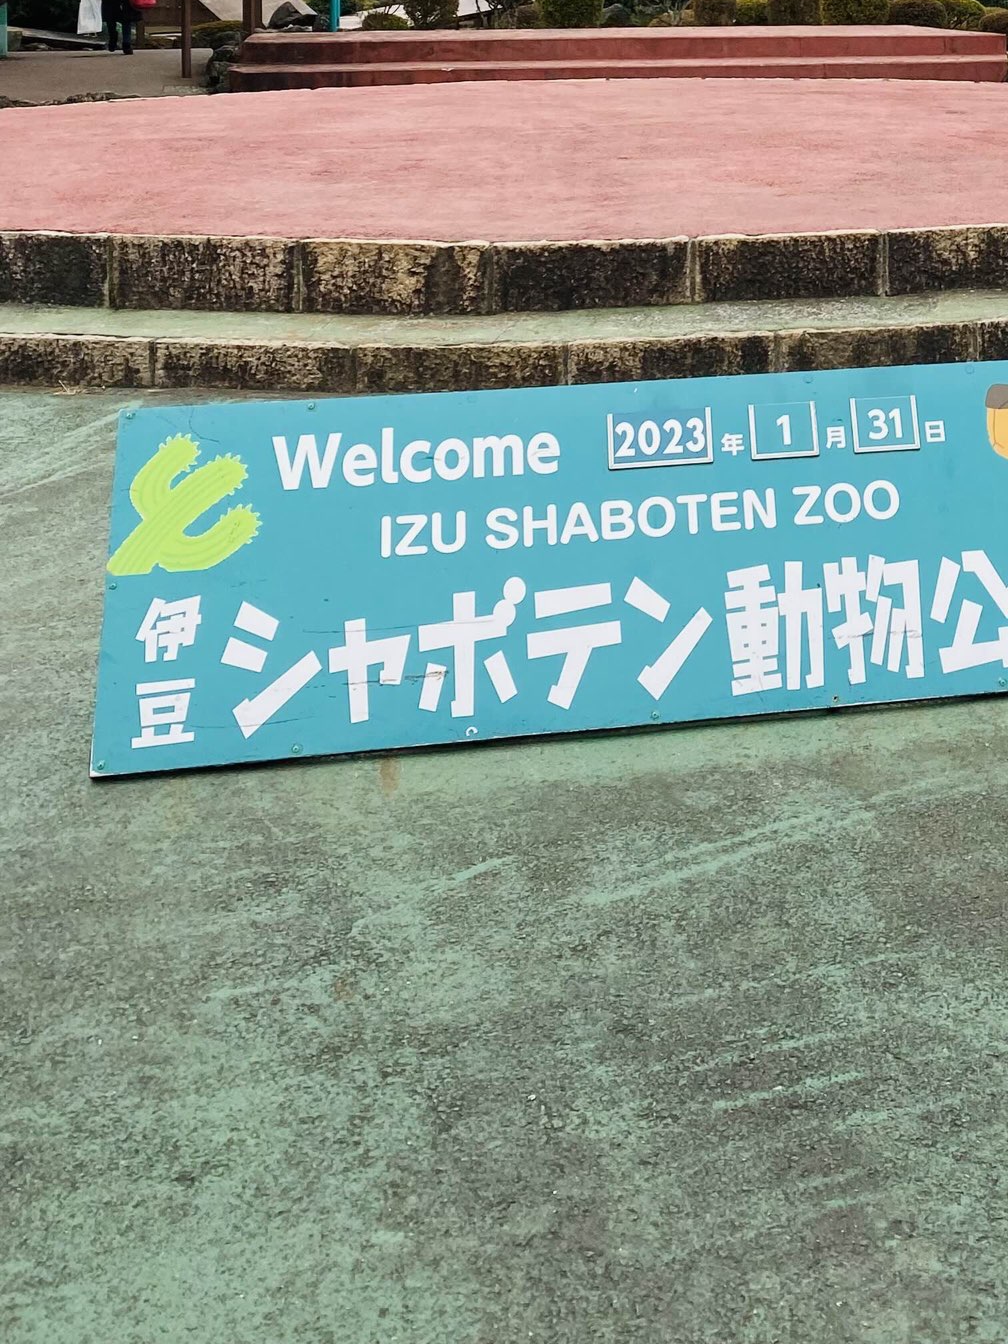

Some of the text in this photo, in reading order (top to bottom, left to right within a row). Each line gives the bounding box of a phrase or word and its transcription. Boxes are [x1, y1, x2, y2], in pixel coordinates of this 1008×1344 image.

[272, 427, 561, 490] Welcome
[614, 417, 705, 457] 2023
[720, 432, 745, 457] 年
[826, 426, 847, 449] 月
[867, 408, 904, 441] 31
[924, 420, 947, 444] 日
[381, 479, 900, 558] IZU SHABOTEN ZOO
[131, 595, 202, 749] 伊豆
